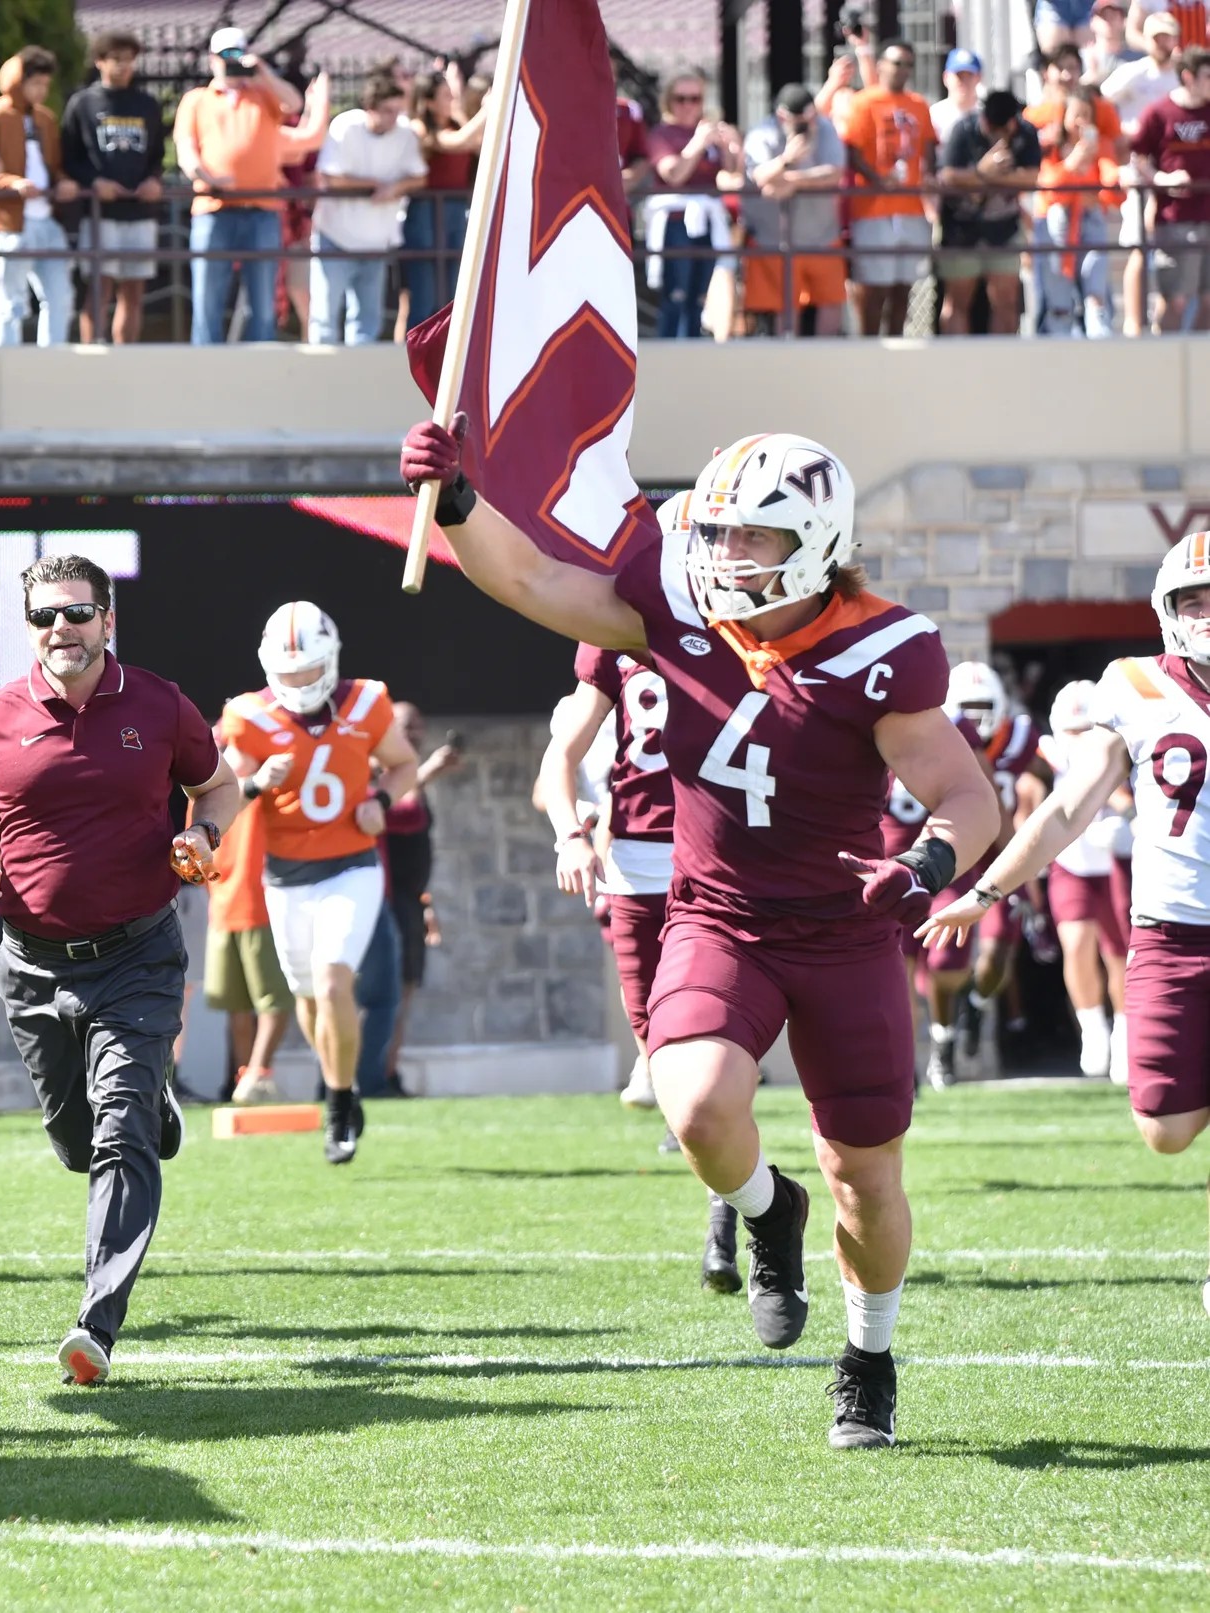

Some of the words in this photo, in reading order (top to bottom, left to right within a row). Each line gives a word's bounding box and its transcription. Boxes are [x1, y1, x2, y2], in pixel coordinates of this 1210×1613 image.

[784, 457, 833, 507] VT
[682, 638, 708, 651] ACC
[864, 663, 893, 701] C
[300, 744, 345, 823] 6
[698, 691, 776, 827] 4
[1152, 732, 1208, 837] 9
